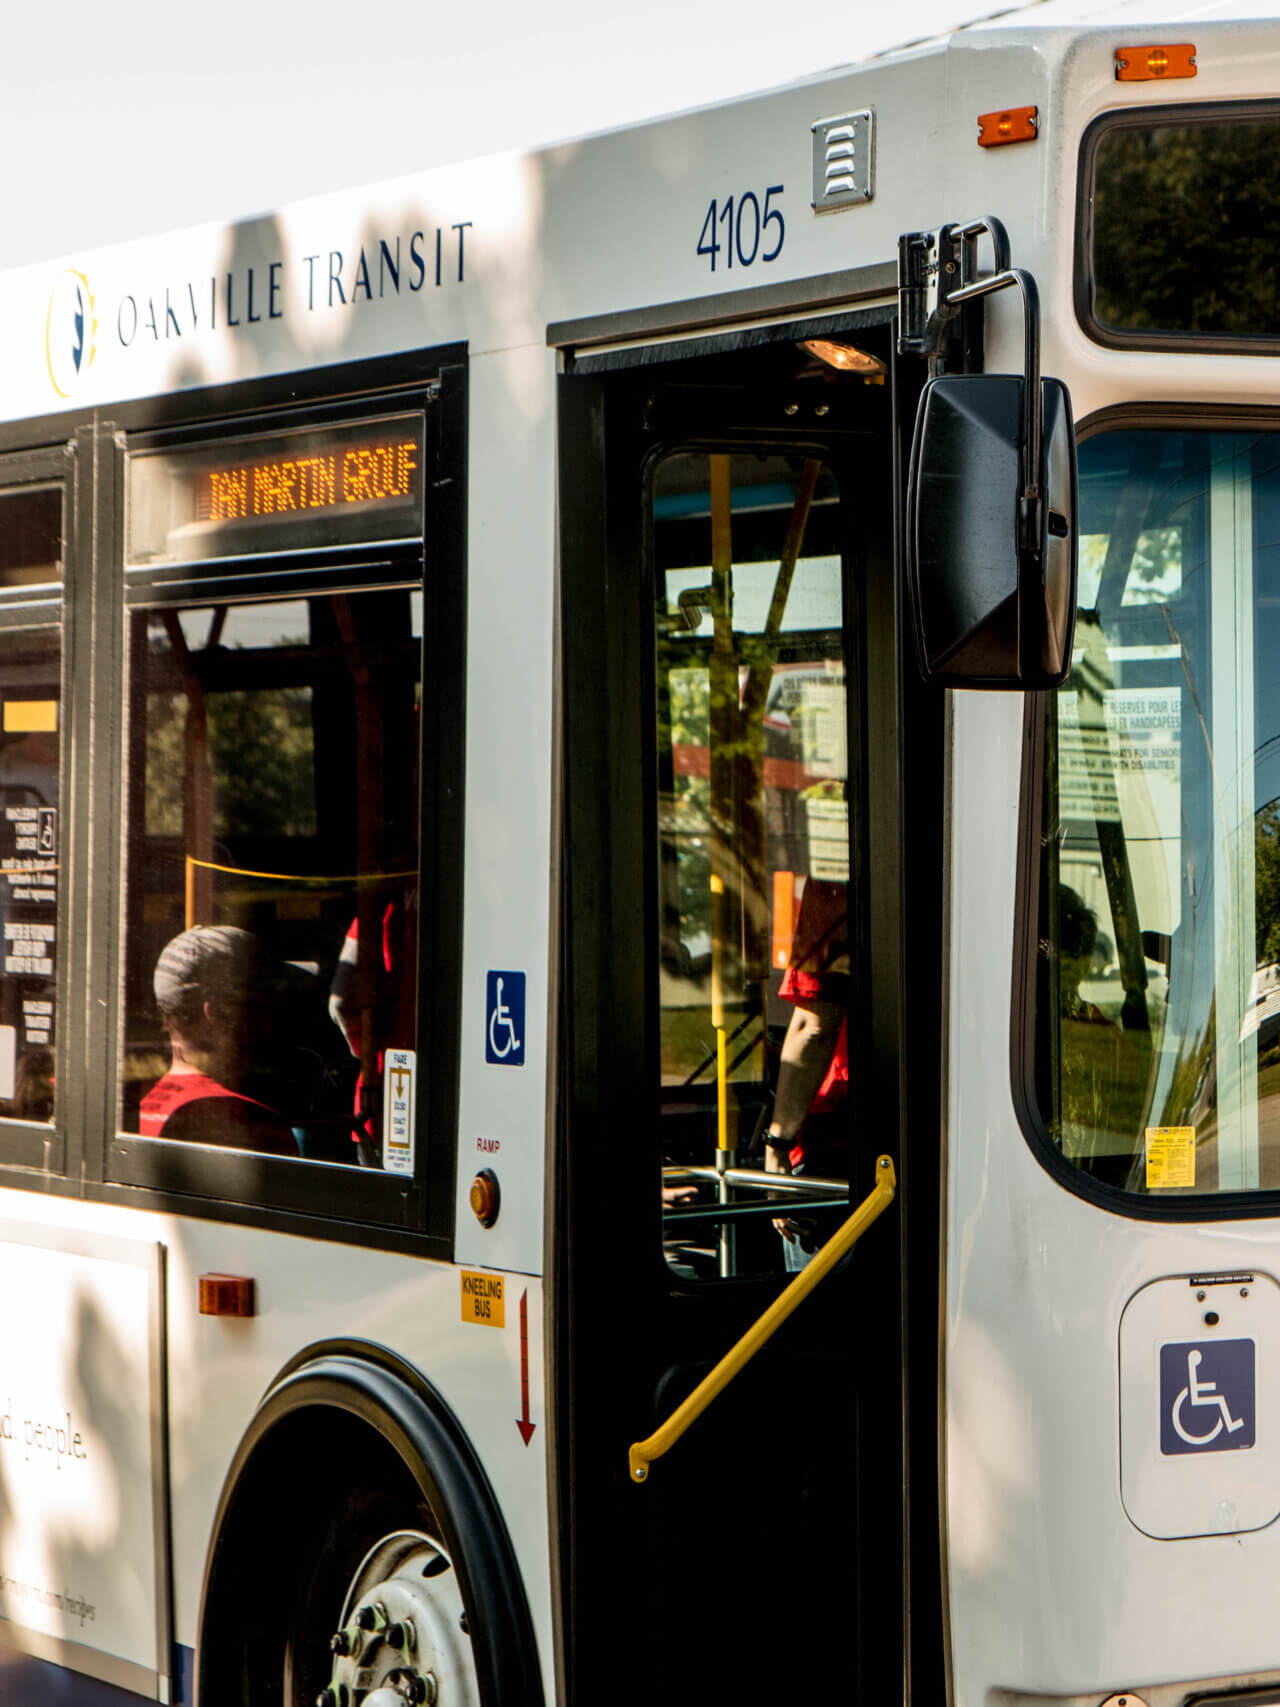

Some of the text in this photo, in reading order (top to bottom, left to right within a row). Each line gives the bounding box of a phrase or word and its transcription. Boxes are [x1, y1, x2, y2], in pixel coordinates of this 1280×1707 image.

[695, 183, 785, 272] 4105
[117, 221, 473, 347] OAKVILLE TRANSIT
[210, 469, 248, 521] IAN
[253, 455, 336, 516] MARTIN
[476, 1137, 501, 1154] RAMP
[462, 1276, 503, 1300] KNEELING
[474, 1299, 492, 1319] BUS
[24, 1412, 88, 1471] people.
